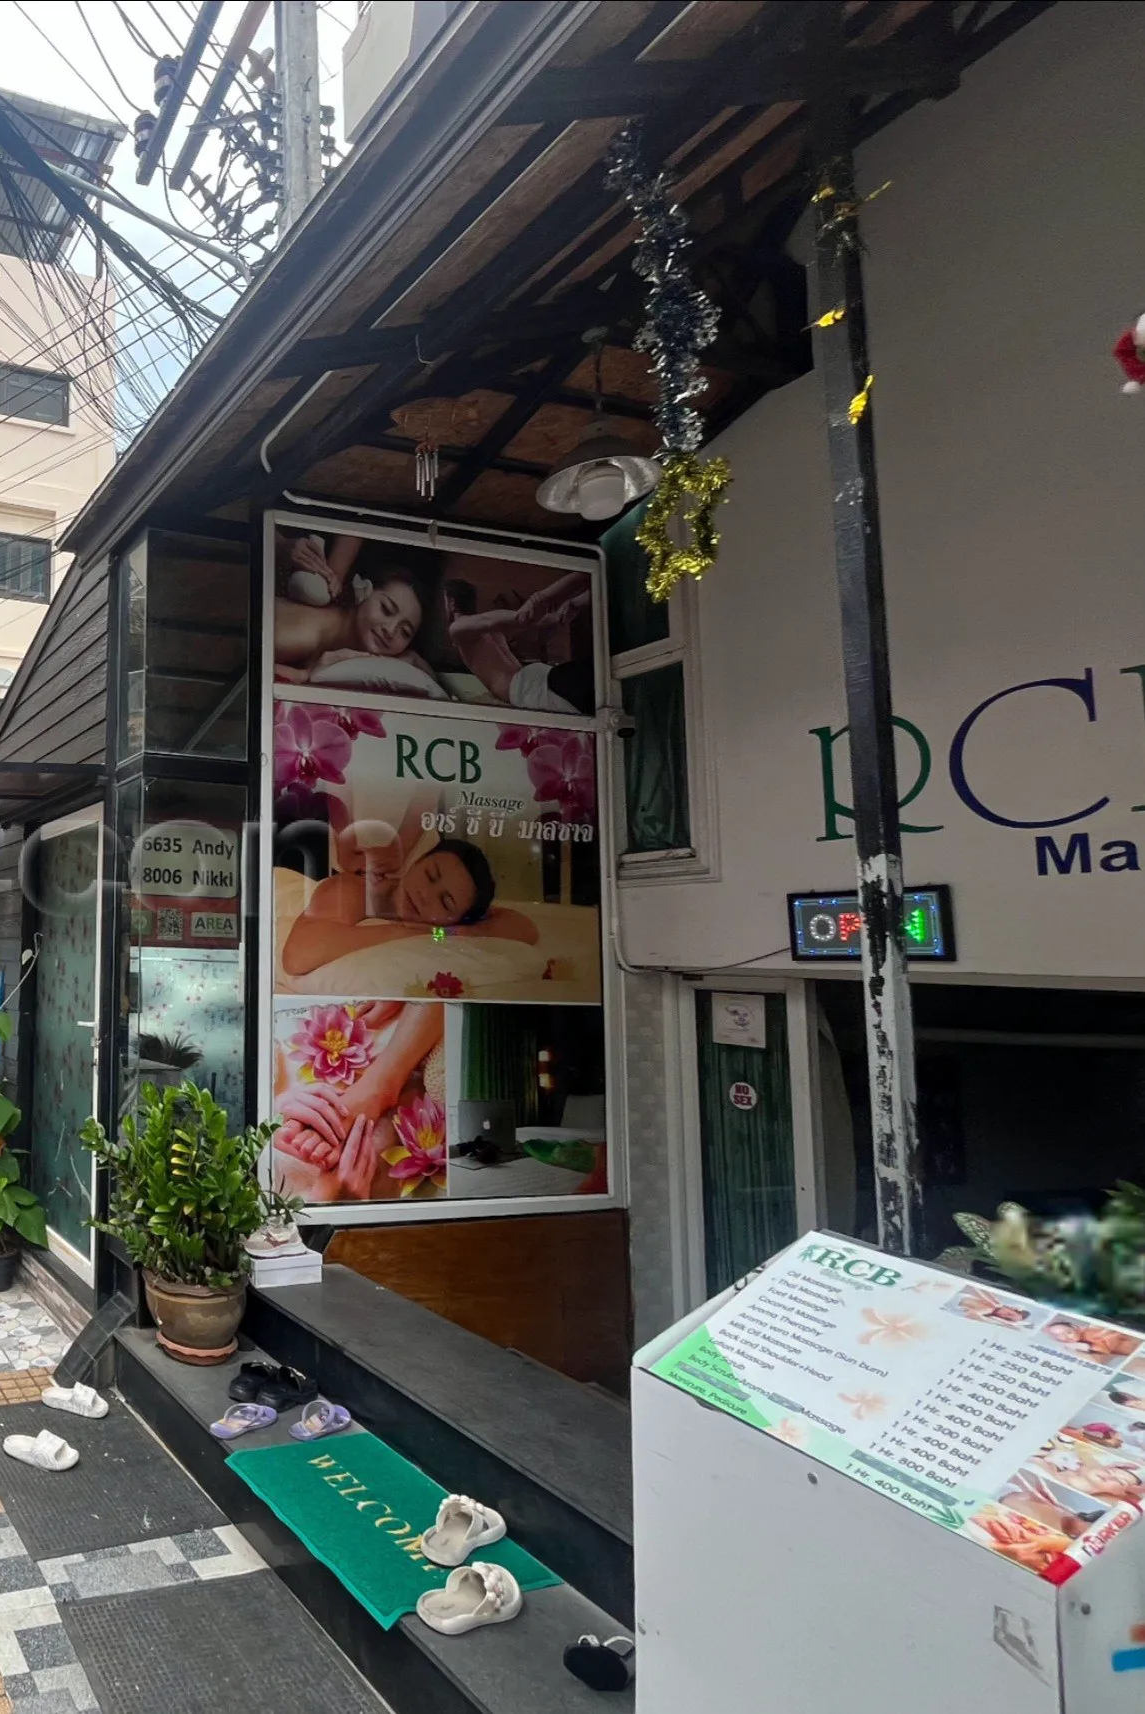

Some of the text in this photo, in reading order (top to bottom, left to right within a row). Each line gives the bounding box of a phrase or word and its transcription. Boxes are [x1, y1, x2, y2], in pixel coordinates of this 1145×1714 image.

[396, 733, 482, 784] RCB
[459, 790, 525, 813] Massage
[421, 806, 459, 833] อาร์
[142, 836, 234, 860] 6635 Andy
[142, 867, 234, 888] 8006 Nikki
[194, 917, 233, 930] AREA
[733, 1094, 753, 1106] SEX
[734, 1084, 750, 1095] NO
[814, 1249, 900, 1286] RCB
[768, 1287, 828, 1312] Foot Massage
[779, 1279, 841, 1304] Thai Massage
[802, 1276, 842, 1293] Massage
[748, 1304, 778, 1318] Aroma
[759, 1296, 836, 1328] Coconut Massage
[707, 1337, 774, 1370] Lotion Massage
[719, 1329, 738, 1340] Back
[740, 1339, 759, 1349] and
[729, 1321, 801, 1354] Milk Oil Massage
[739, 1313, 768, 1327] Aroma
[791, 1333, 833, 1354] Massage
[834, 1352, 857, 1364] (Sun
[699, 1346, 745, 1370] Body Scrub
[979, 1353, 995, 1361] Hr.
[1000, 1361, 1027, 1373] 250
[1029, 1371, 1062, 1385] Baht
[990, 1343, 1006, 1353] Hr.
[1012, 1351, 1039, 1363] 350
[1041, 1361, 1073, 1375] Baht
[688, 1354, 709, 1367] Body
[798, 1407, 845, 1434] Massage
[957, 1373, 973, 1383] Hr.
[979, 1383, 1005, 1395] 400
[1007, 1393, 1039, 1408] Baht
[968, 1363, 984, 1373] Hr.
[989, 1371, 1016, 1384] 250
[1018, 1382, 1050, 1397] Baht
[709, 1392, 747, 1414] Pedicure
[935, 1394, 950, 1405] Hr.
[956, 1404, 982, 1416] 400
[984, 1414, 1016, 1430] Baht
[946, 1383, 963, 1394] Hr.
[968, 1393, 993, 1405] 400
[995, 1403, 1027, 1419] Baht
[913, 1415, 928, 1426] Hr.
[933, 1425, 959, 1439] 300
[961, 1437, 992, 1453] Baht
[923, 1404, 939, 1415] Hr.
[945, 1415, 971, 1427] 400
[973, 1426, 1004, 1441] Baht
[890, 1437, 905, 1448] Hr.
[911, 1448, 936, 1461] 400
[938, 1459, 969, 1476] Baht
[901, 1426, 917, 1437] Hr.
[922, 1437, 948, 1450] 400
[949, 1448, 980, 1465] Baht
[878, 1447, 894, 1457] Hr.
[925, 1471, 956, 1488] Baht
[854, 1468, 870, 1478] Hr.
[875, 1480, 900, 1494] 400
[901, 1493, 933, 1510] Baht
[307, 1453, 443, 1573] WELCOM
